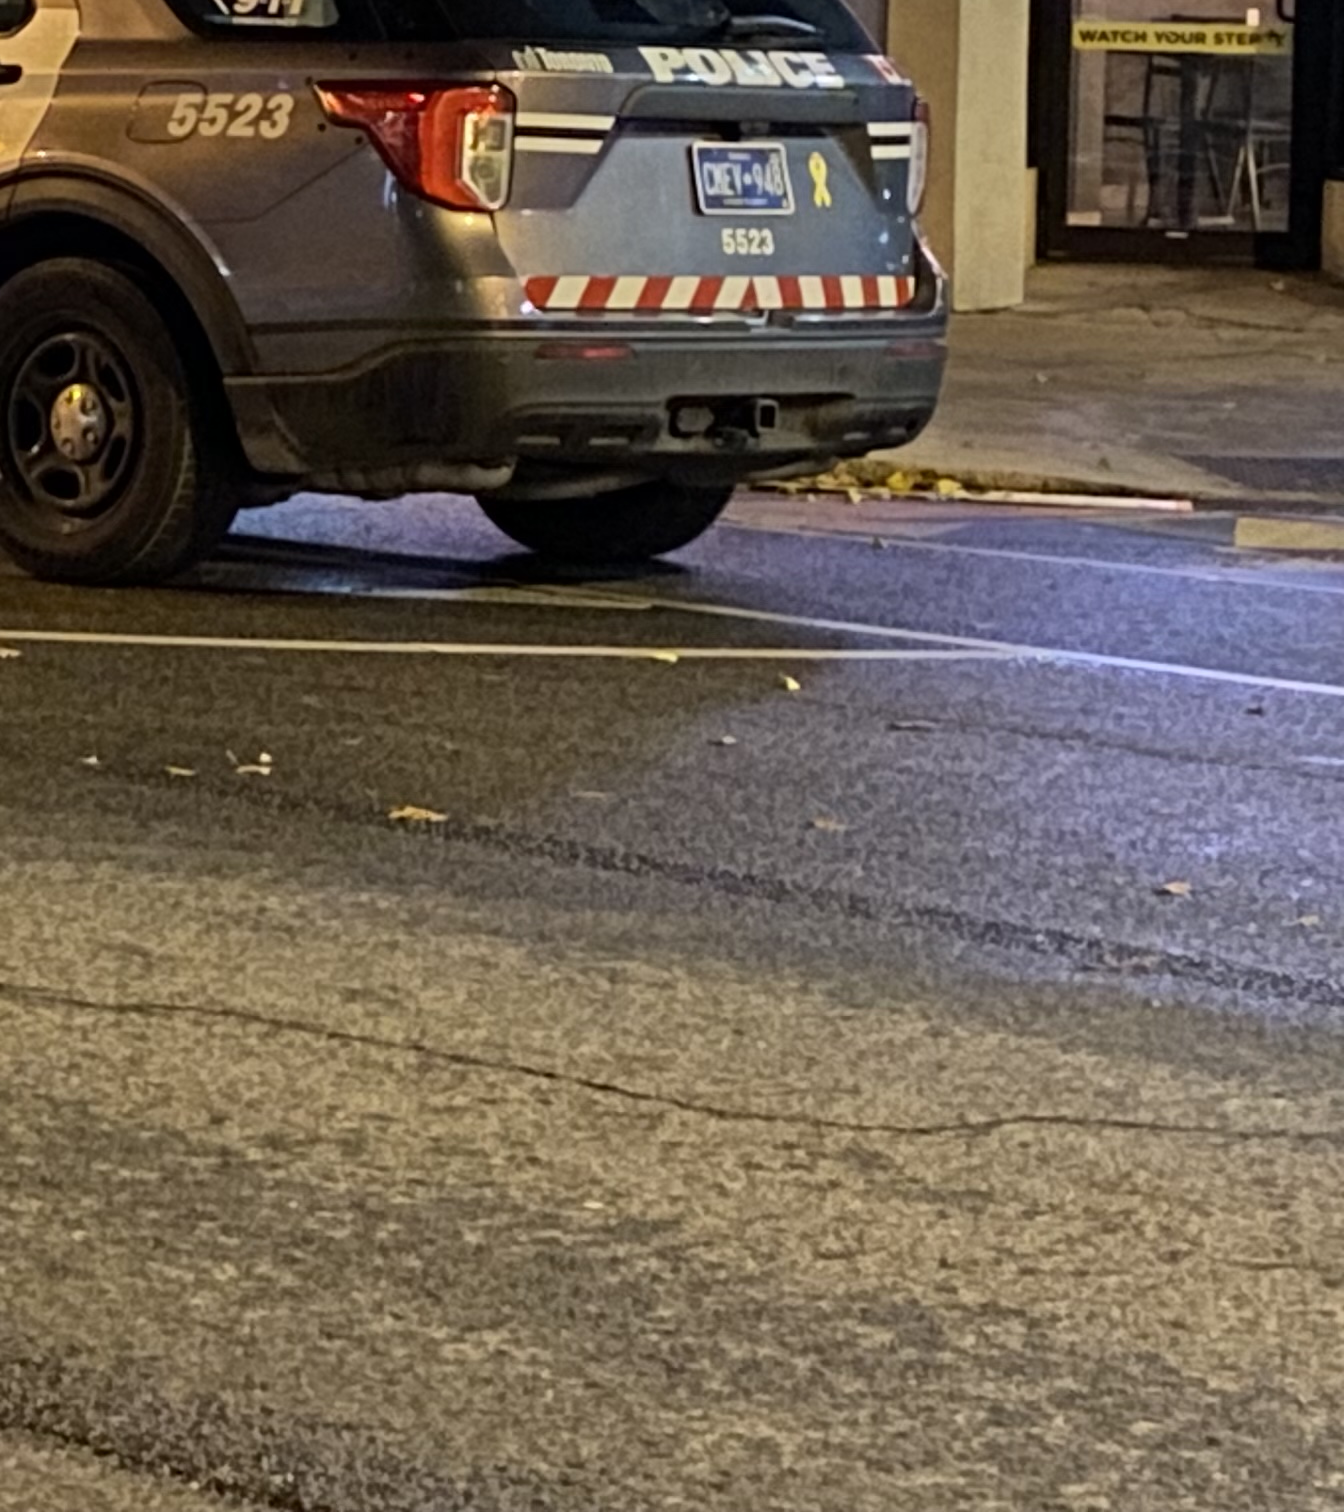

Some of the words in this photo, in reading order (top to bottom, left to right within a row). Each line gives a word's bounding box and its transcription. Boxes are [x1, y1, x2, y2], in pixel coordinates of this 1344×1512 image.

[1078, 29, 1148, 44] WATCH
[1154, 31, 1207, 45] YOUR
[1213, 31, 1260, 46] STEP
[638, 46, 845, 89] POLICE
[166, 92, 295, 139] 5523
[721, 227, 775, 256] 5523
